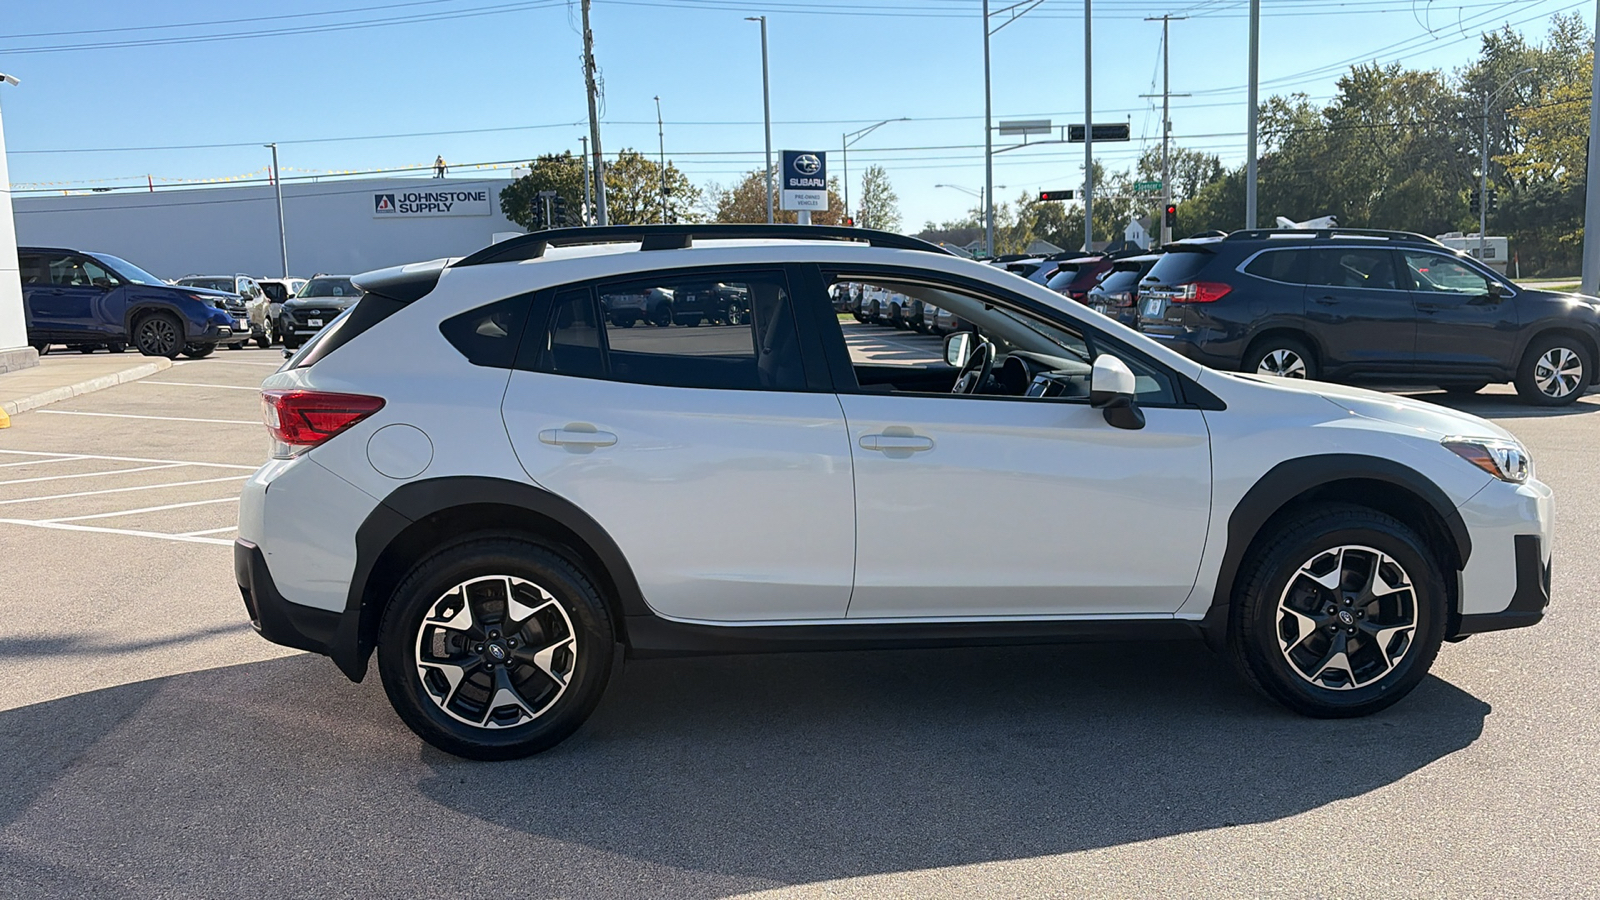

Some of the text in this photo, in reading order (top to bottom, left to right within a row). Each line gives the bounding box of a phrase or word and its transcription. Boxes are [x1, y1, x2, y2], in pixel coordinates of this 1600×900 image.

[789, 178, 825, 187] SUBARU
[398, 191, 487, 203] JOHNSTONE
[399, 202, 454, 214] SUPPLY
